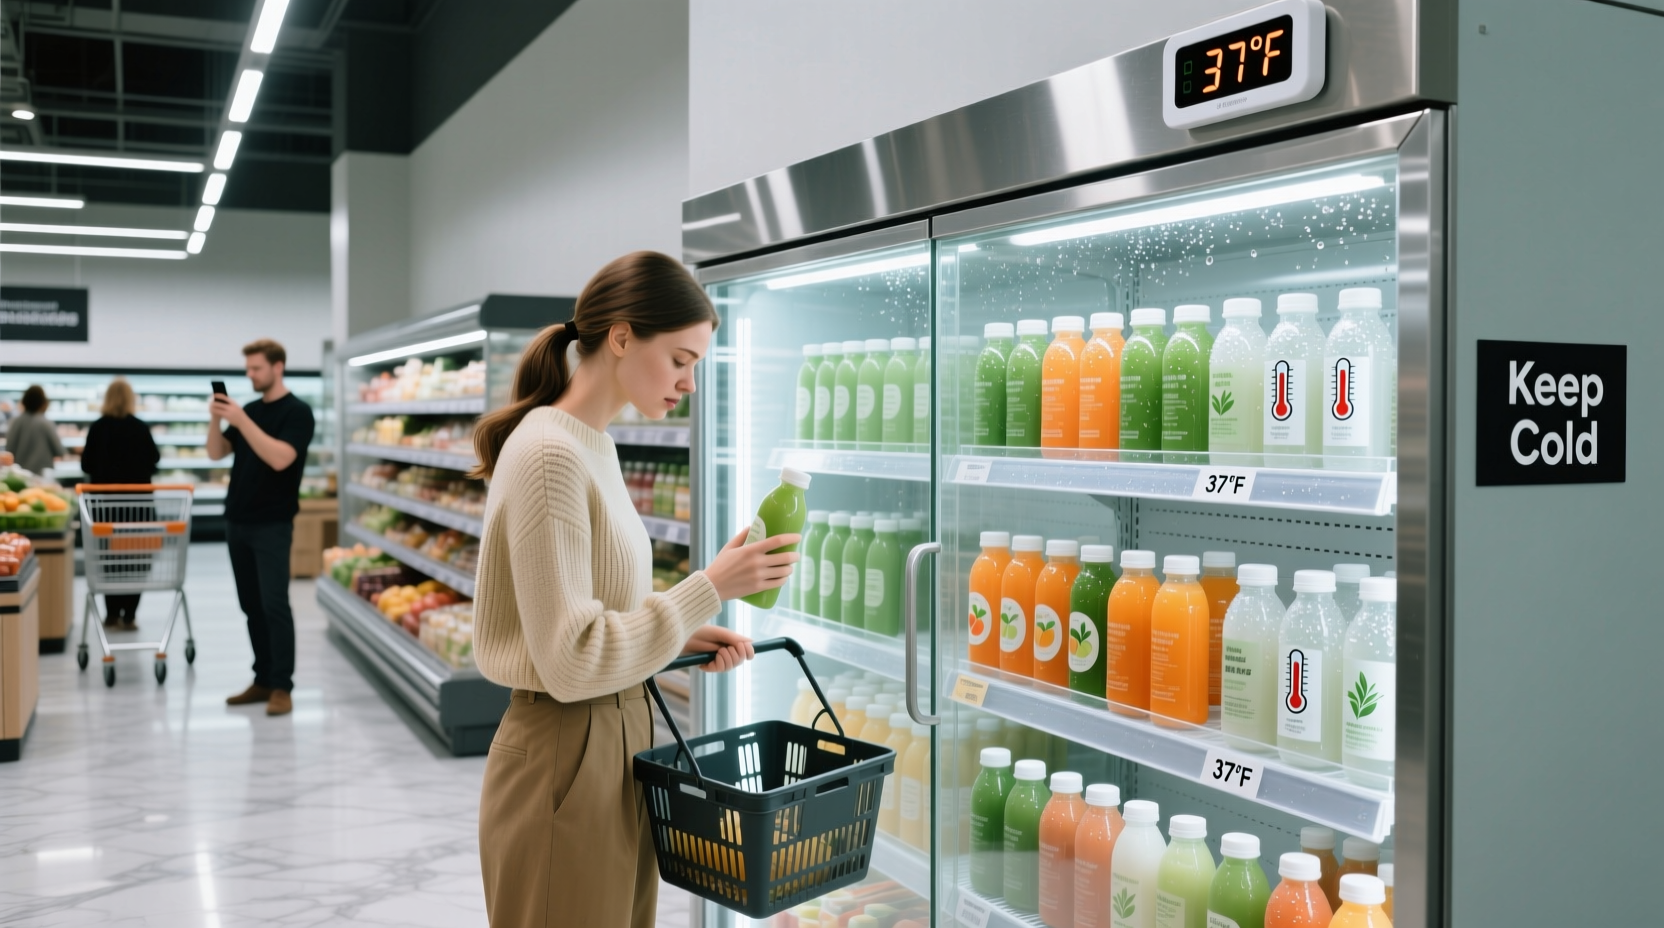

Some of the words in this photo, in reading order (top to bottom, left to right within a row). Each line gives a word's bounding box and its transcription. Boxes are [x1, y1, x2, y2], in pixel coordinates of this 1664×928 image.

[1202, 29, 1284, 94] 37°F
[1508, 360, 1604, 418] Keep
[1509, 418, 1598, 466] Cold
[1205, 474, 1246, 494] 37°F
[1212, 758, 1253, 787] 37°F
